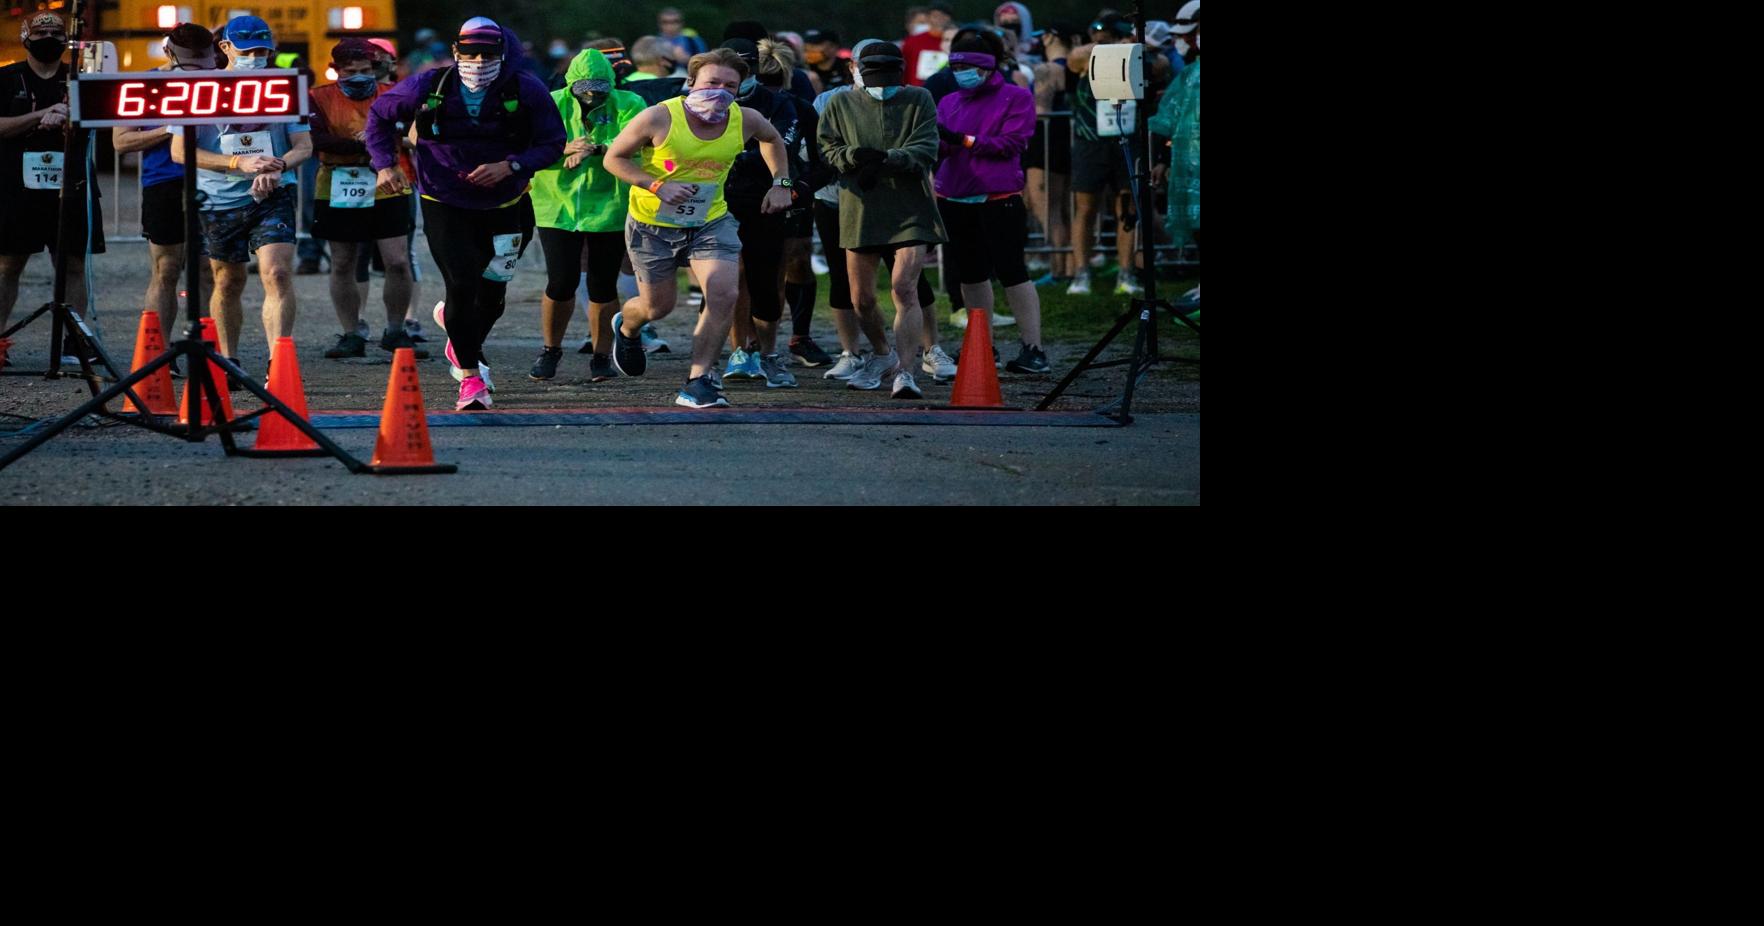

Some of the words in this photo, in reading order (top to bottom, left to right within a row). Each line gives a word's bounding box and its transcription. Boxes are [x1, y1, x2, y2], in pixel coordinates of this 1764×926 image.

[117, 79, 290, 117] 6:20:05
[35, 173, 58, 183] 114
[342, 188, 366, 197] 109
[675, 204, 696, 216] 53
